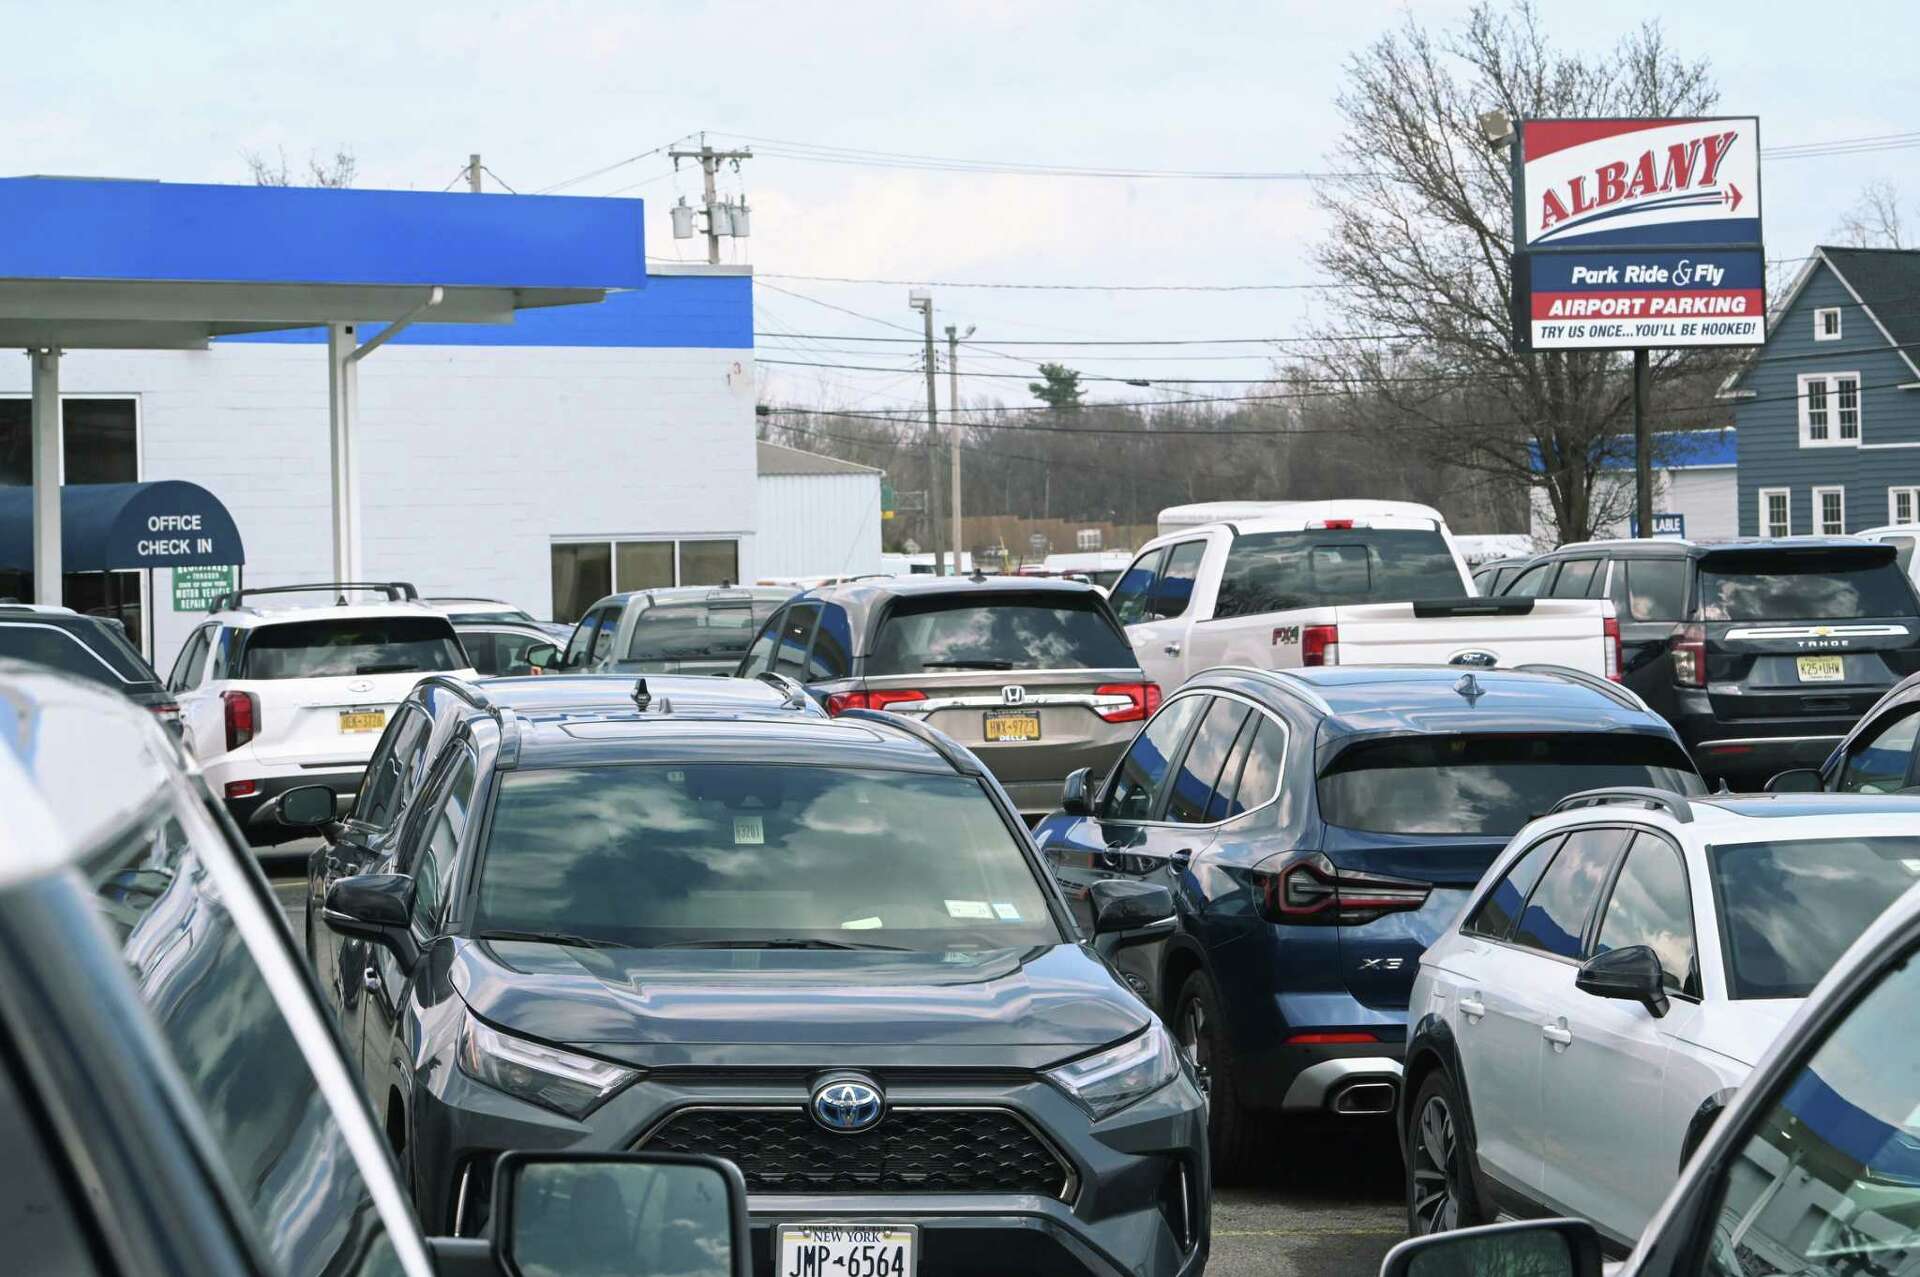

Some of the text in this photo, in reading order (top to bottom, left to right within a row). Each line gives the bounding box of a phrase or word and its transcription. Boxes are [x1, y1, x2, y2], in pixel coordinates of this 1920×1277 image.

[1540, 131, 1738, 230] ALBANY
[1571, 259, 1725, 287] Park Ride & Fly
[1548, 296, 1746, 317] AIRPORT PARKING
[1540, 326, 1566, 338] TRY
[1568, 325, 1585, 338] US
[1681, 323, 1697, 336] BE
[1701, 322, 1756, 336] HOOKED!
[148, 515, 202, 532] OFFICE
[137, 538, 213, 556] CHECK IN
[176, 588, 199, 599] MOTOR
[181, 599, 206, 609] REPAIR
[1272, 625, 1299, 645] FX4
[1797, 640, 1849, 648] TAHOE
[1358, 957, 1404, 970] X3
[813, 1231, 881, 1243] NEW YORK
